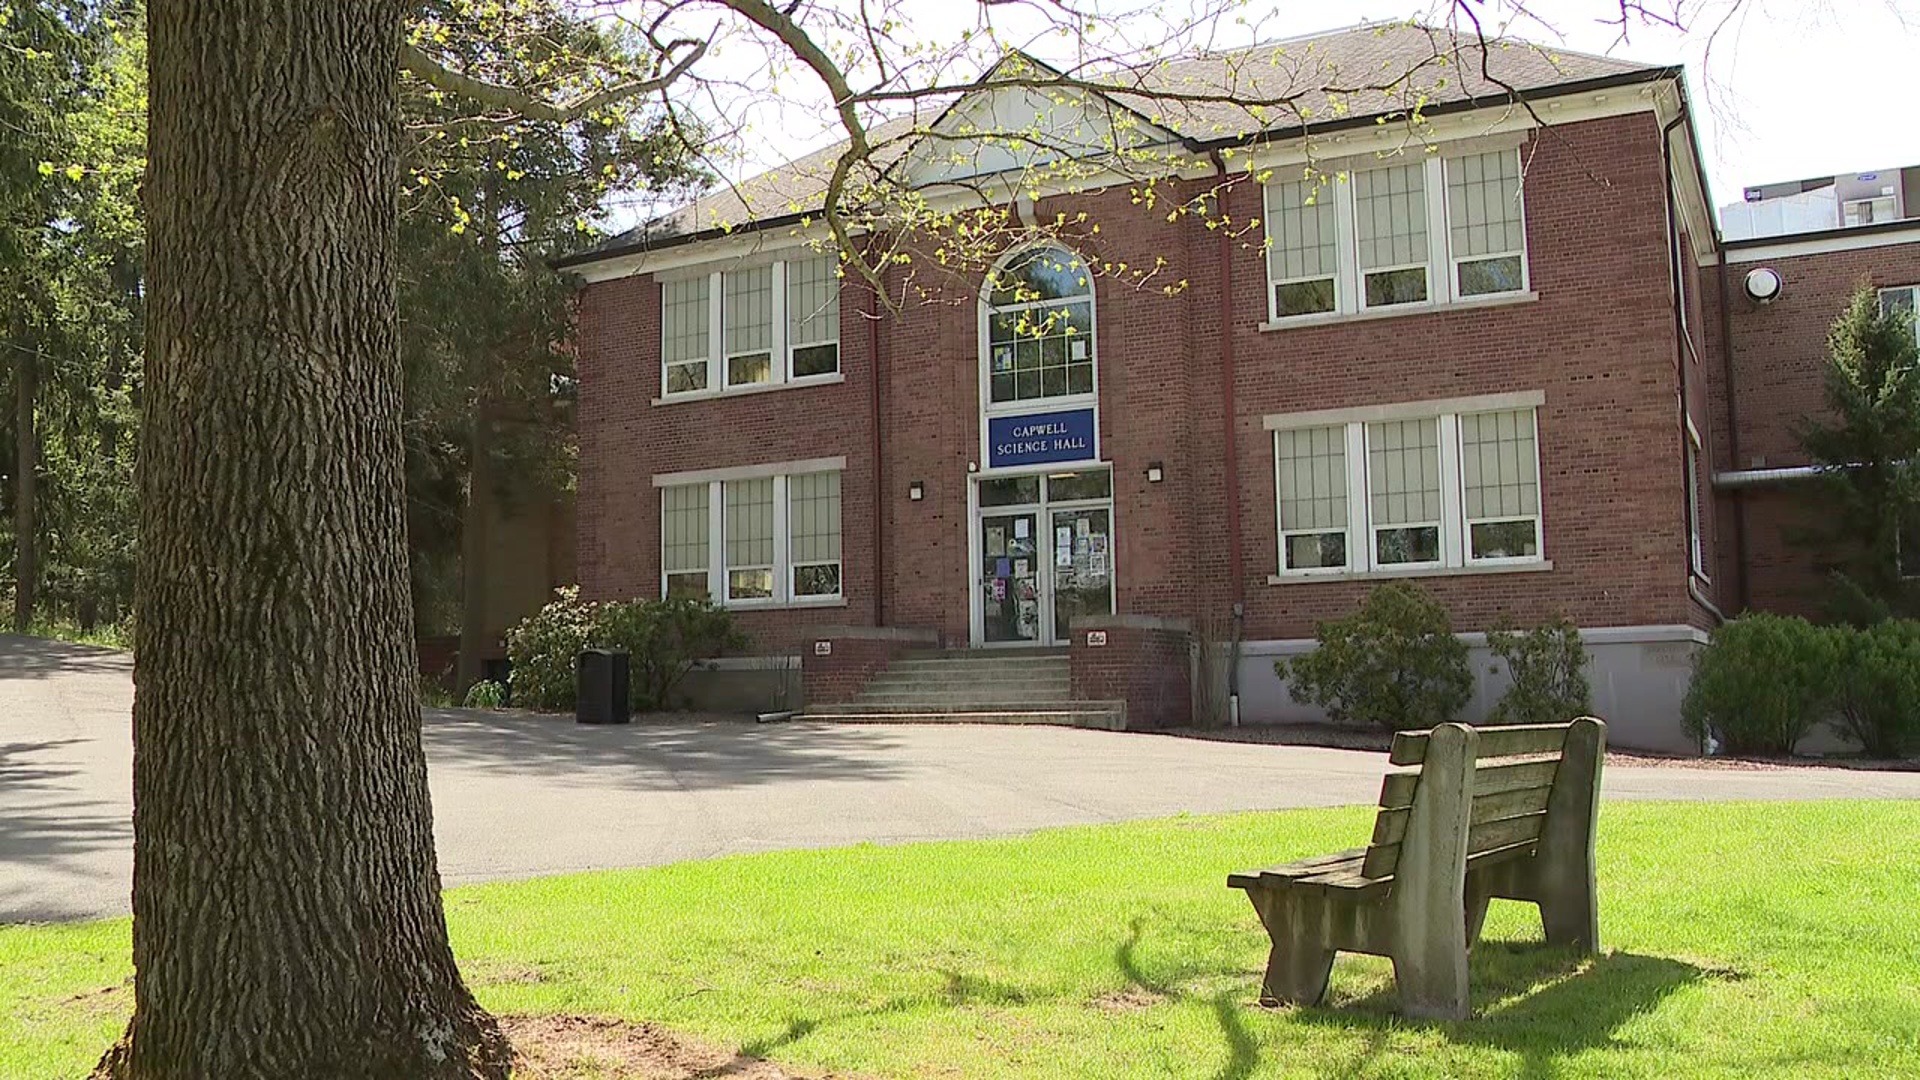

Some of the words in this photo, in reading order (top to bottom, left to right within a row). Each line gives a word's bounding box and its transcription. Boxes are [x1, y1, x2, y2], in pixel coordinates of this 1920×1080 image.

[1013, 422, 1068, 438] CAPWELL
[997, 440, 1048, 456] SCIENCE
[1053, 437, 1086, 450] HALL
